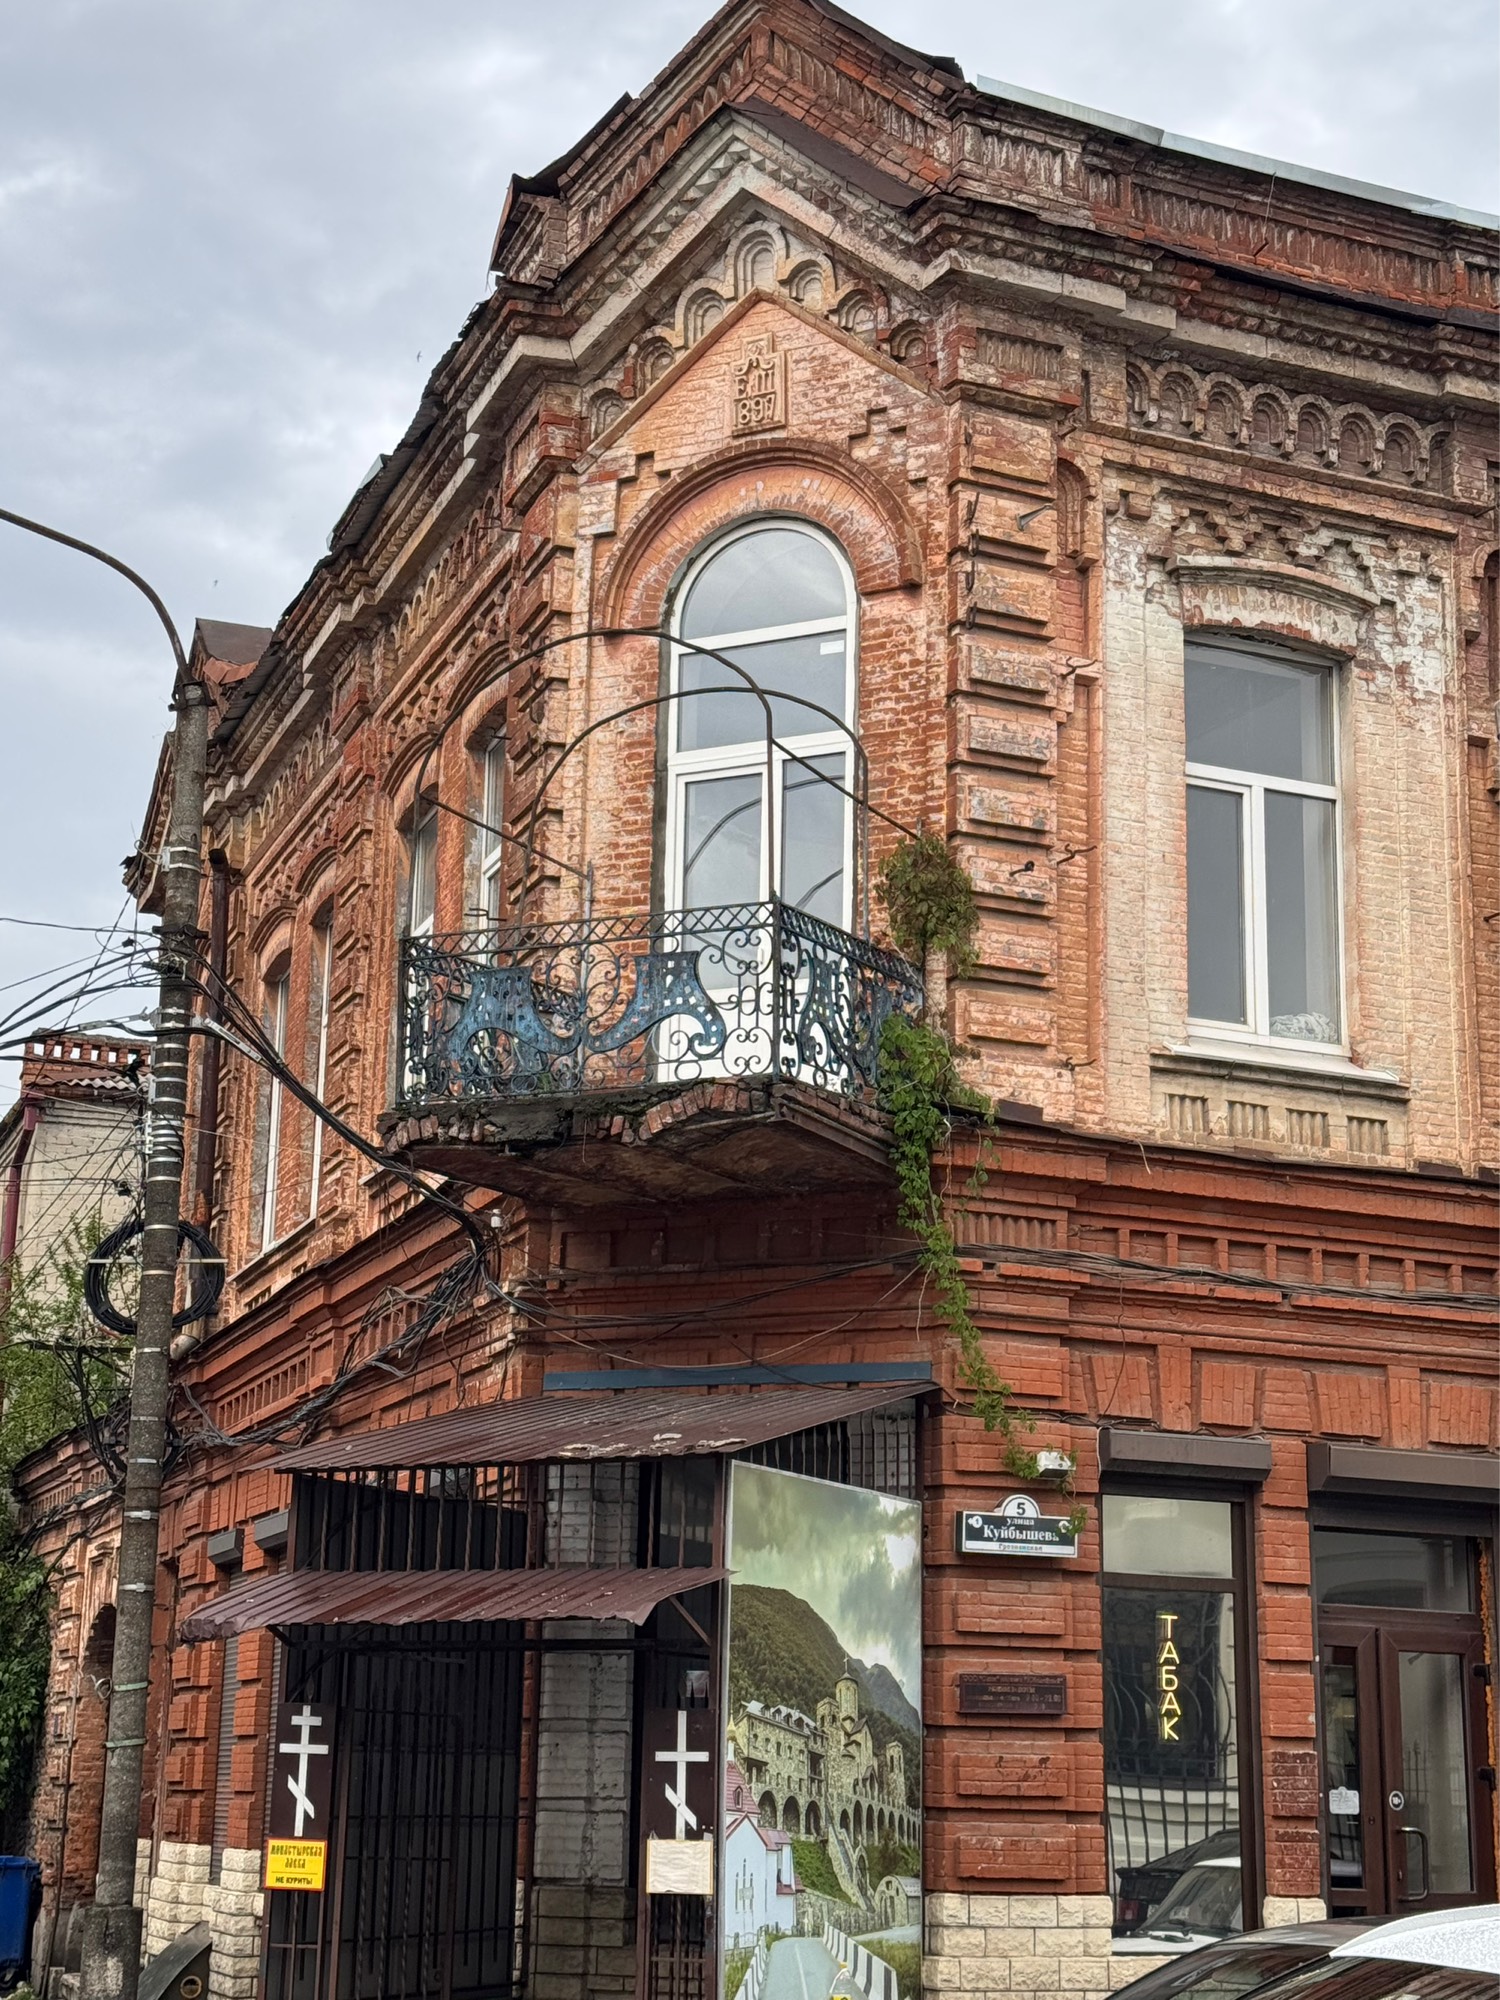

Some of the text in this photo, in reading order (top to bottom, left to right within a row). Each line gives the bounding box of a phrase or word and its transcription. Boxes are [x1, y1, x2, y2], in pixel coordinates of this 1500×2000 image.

[1016, 1502, 1026, 1516] 5
[1006, 1517, 1035, 1527] улица
[983, 1524, 1060, 1542] Куйбышева
[1158, 1614, 1182, 1741] ТАБАК
[275, 1876, 285, 1884] НЕ
